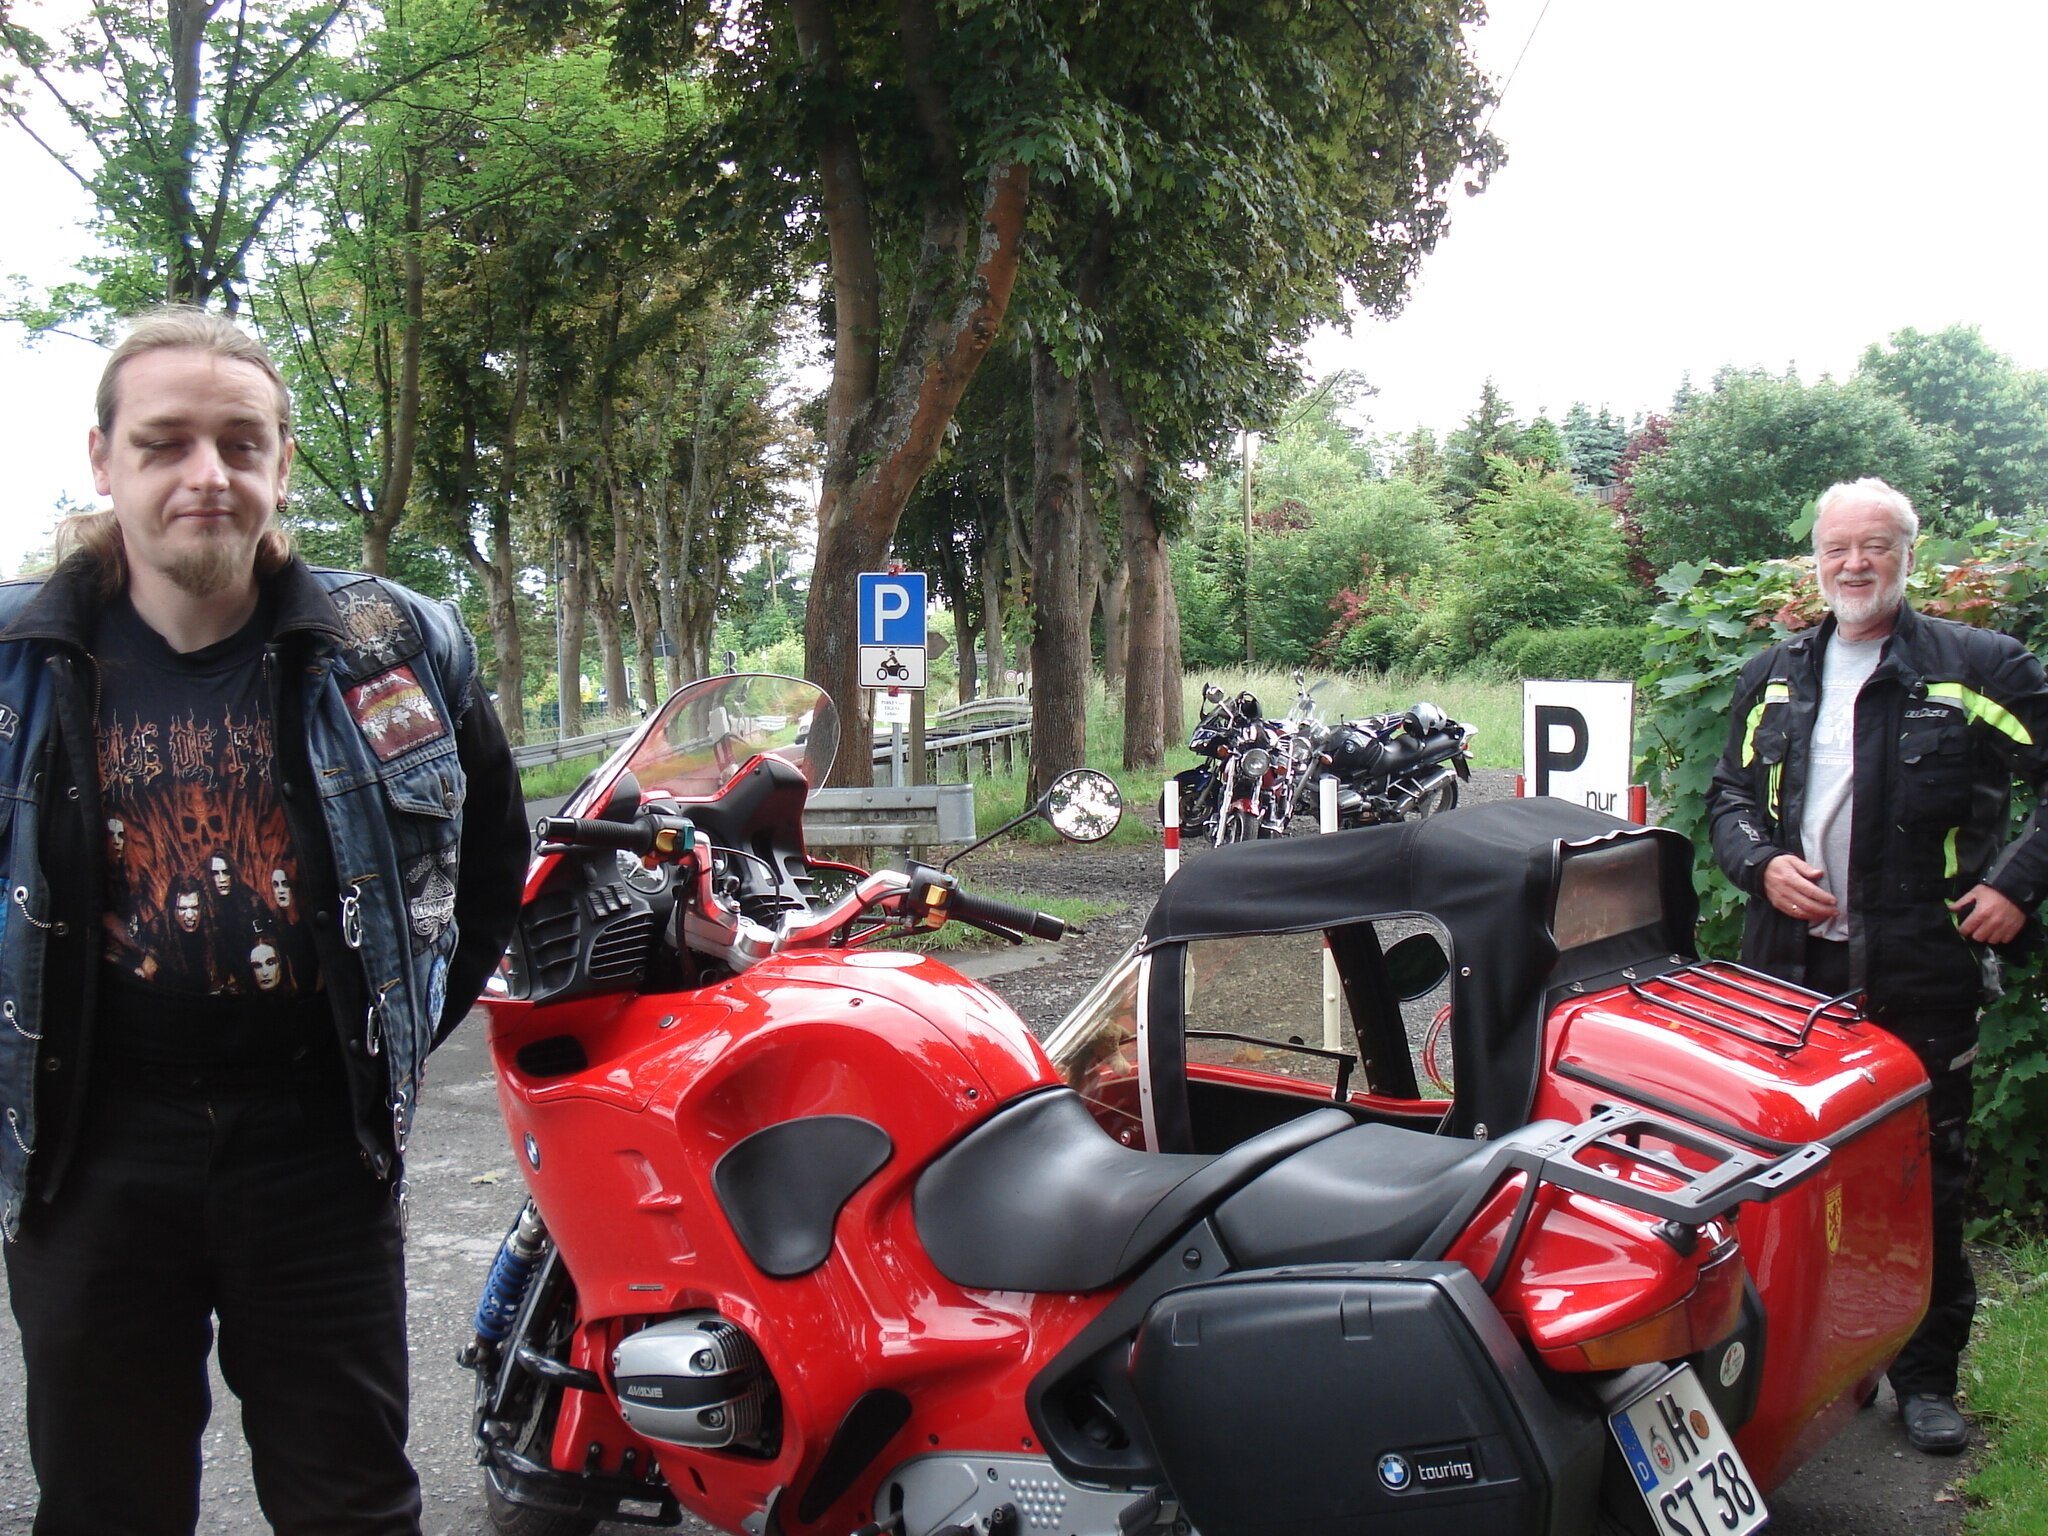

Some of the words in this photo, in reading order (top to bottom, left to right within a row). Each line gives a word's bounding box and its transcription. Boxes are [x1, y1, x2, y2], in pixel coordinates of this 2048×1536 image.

[875, 584, 910, 641] P
[1535, 704, 1590, 797] P
[1586, 790, 1618, 812] nur
[1656, 1391, 1700, 1464] H
[1418, 1461, 1474, 1481] touring
